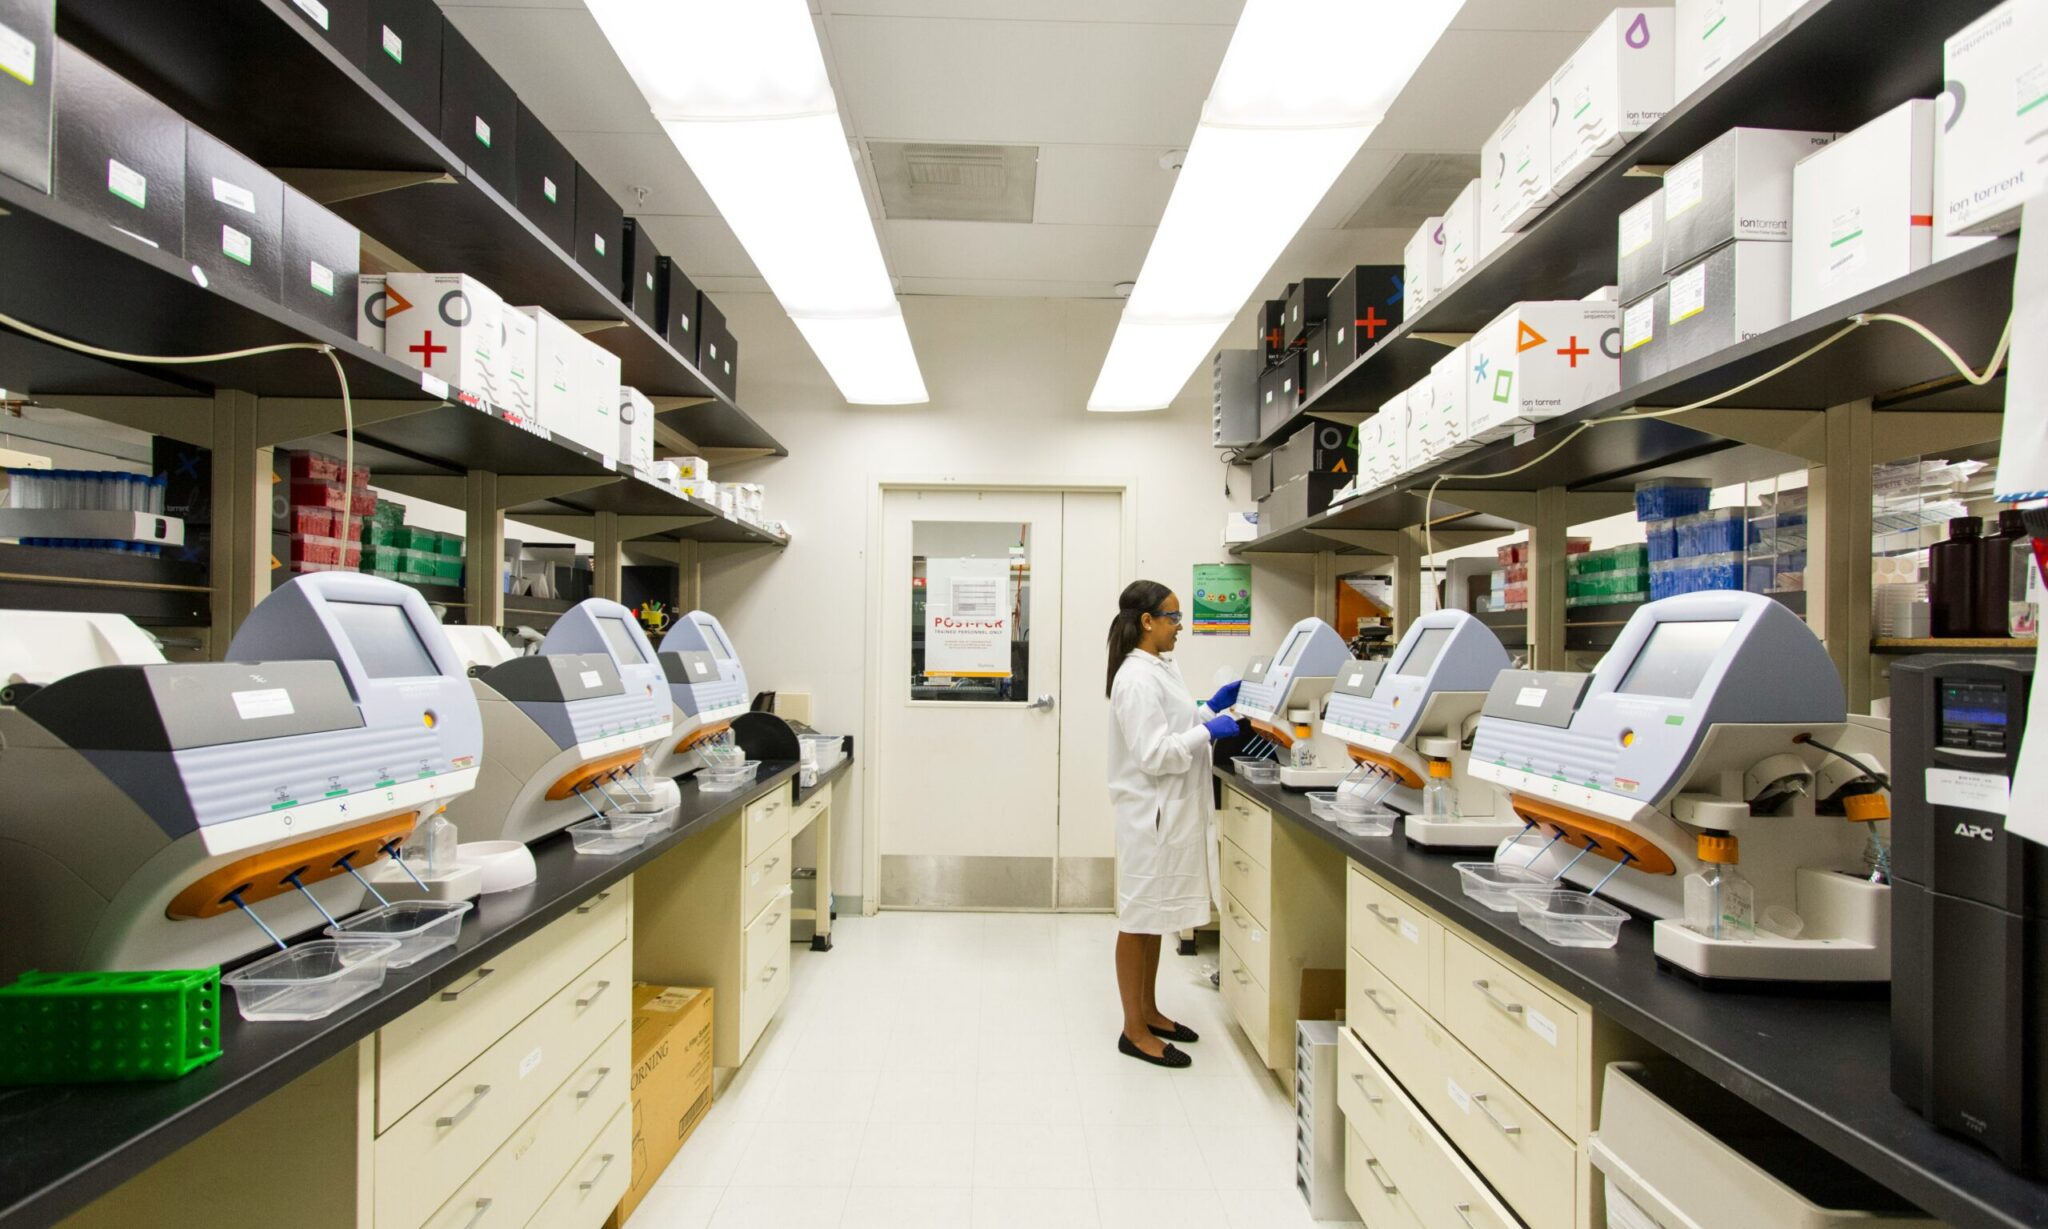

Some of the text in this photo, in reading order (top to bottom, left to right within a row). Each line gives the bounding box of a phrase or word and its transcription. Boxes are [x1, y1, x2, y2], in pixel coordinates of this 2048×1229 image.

[1952, 16, 2013, 58] sequencing
[1627, 111, 1639, 119] ion
[1950, 198, 1969, 214] ion
[1974, 170, 2025, 203] torrent
[1954, 822, 1993, 842] APC
[631, 1040, 669, 1091] ORNING
